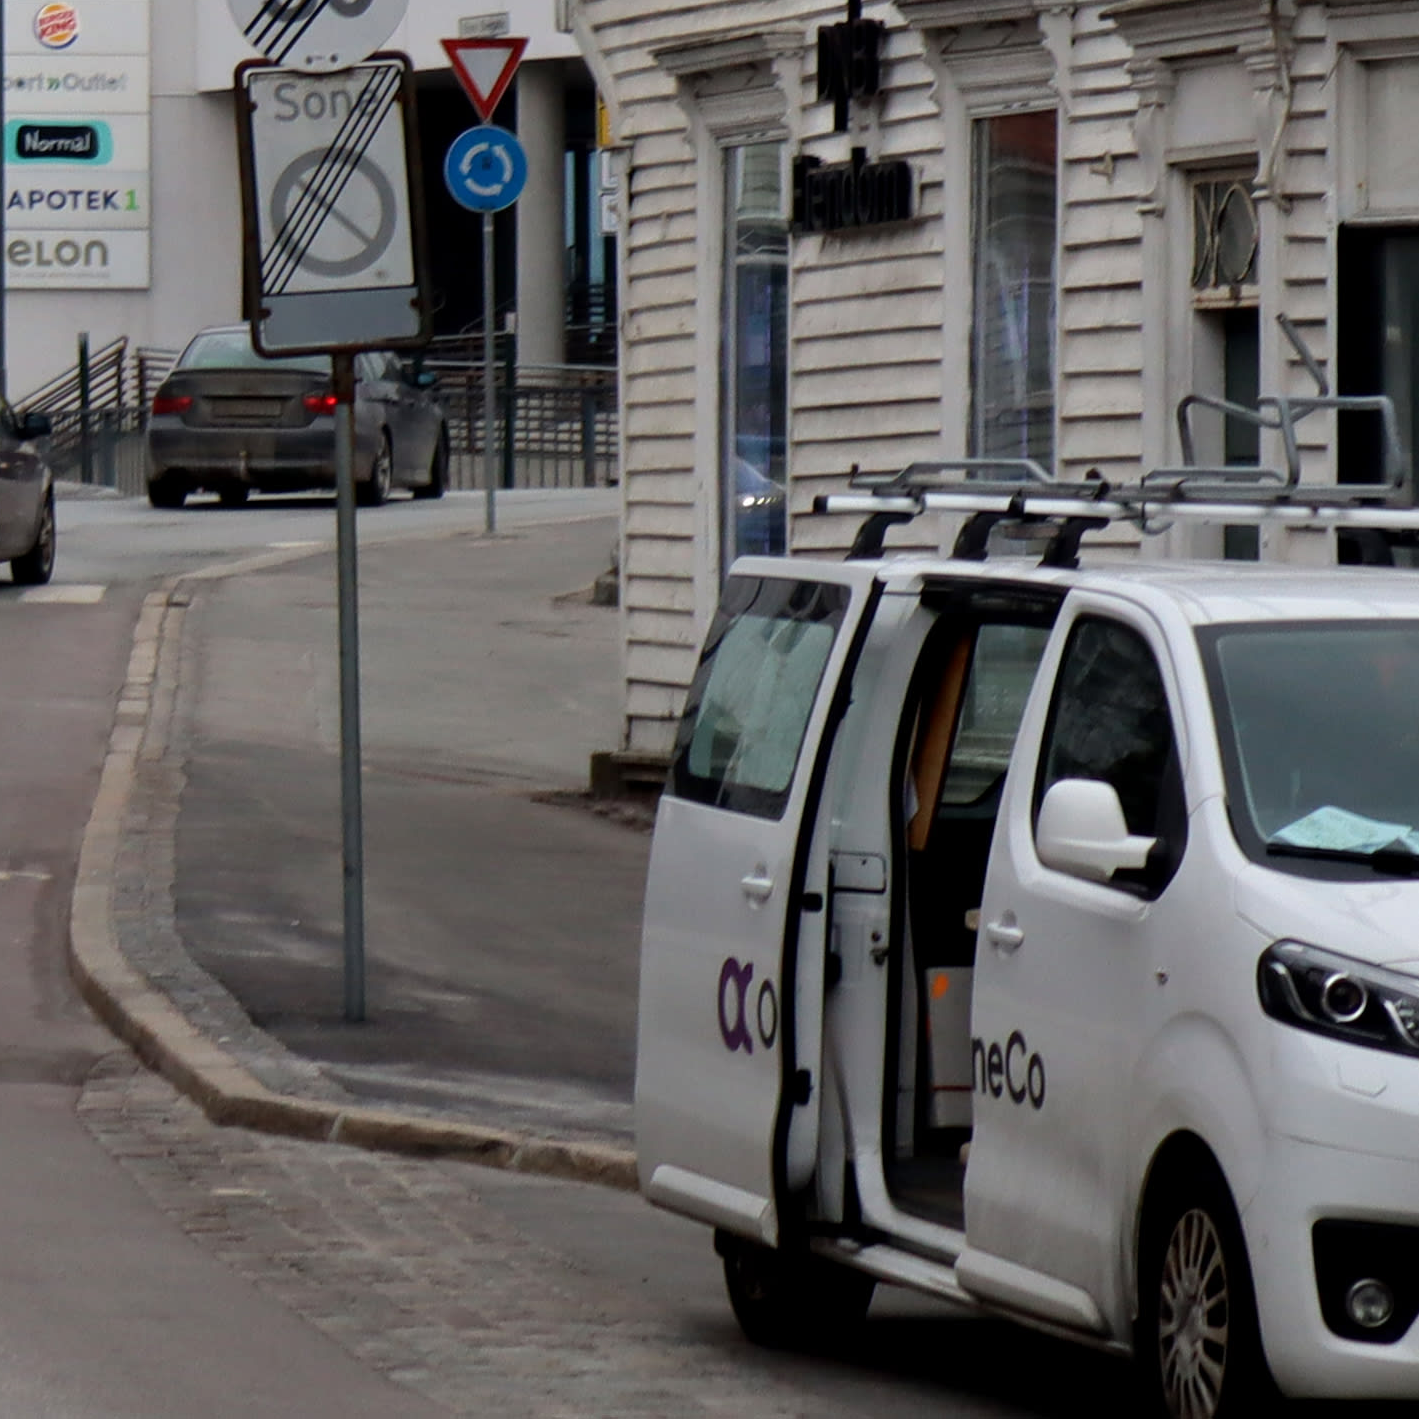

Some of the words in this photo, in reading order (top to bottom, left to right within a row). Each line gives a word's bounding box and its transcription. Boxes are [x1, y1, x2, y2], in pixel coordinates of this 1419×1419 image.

[39, 18, 77, 40] KING
[274, 82, 379, 122] Sone
[24, 129, 91, 152] Normal
[6, 189, 120, 211] APOTEK
[125, 189, 140, 211] 1
